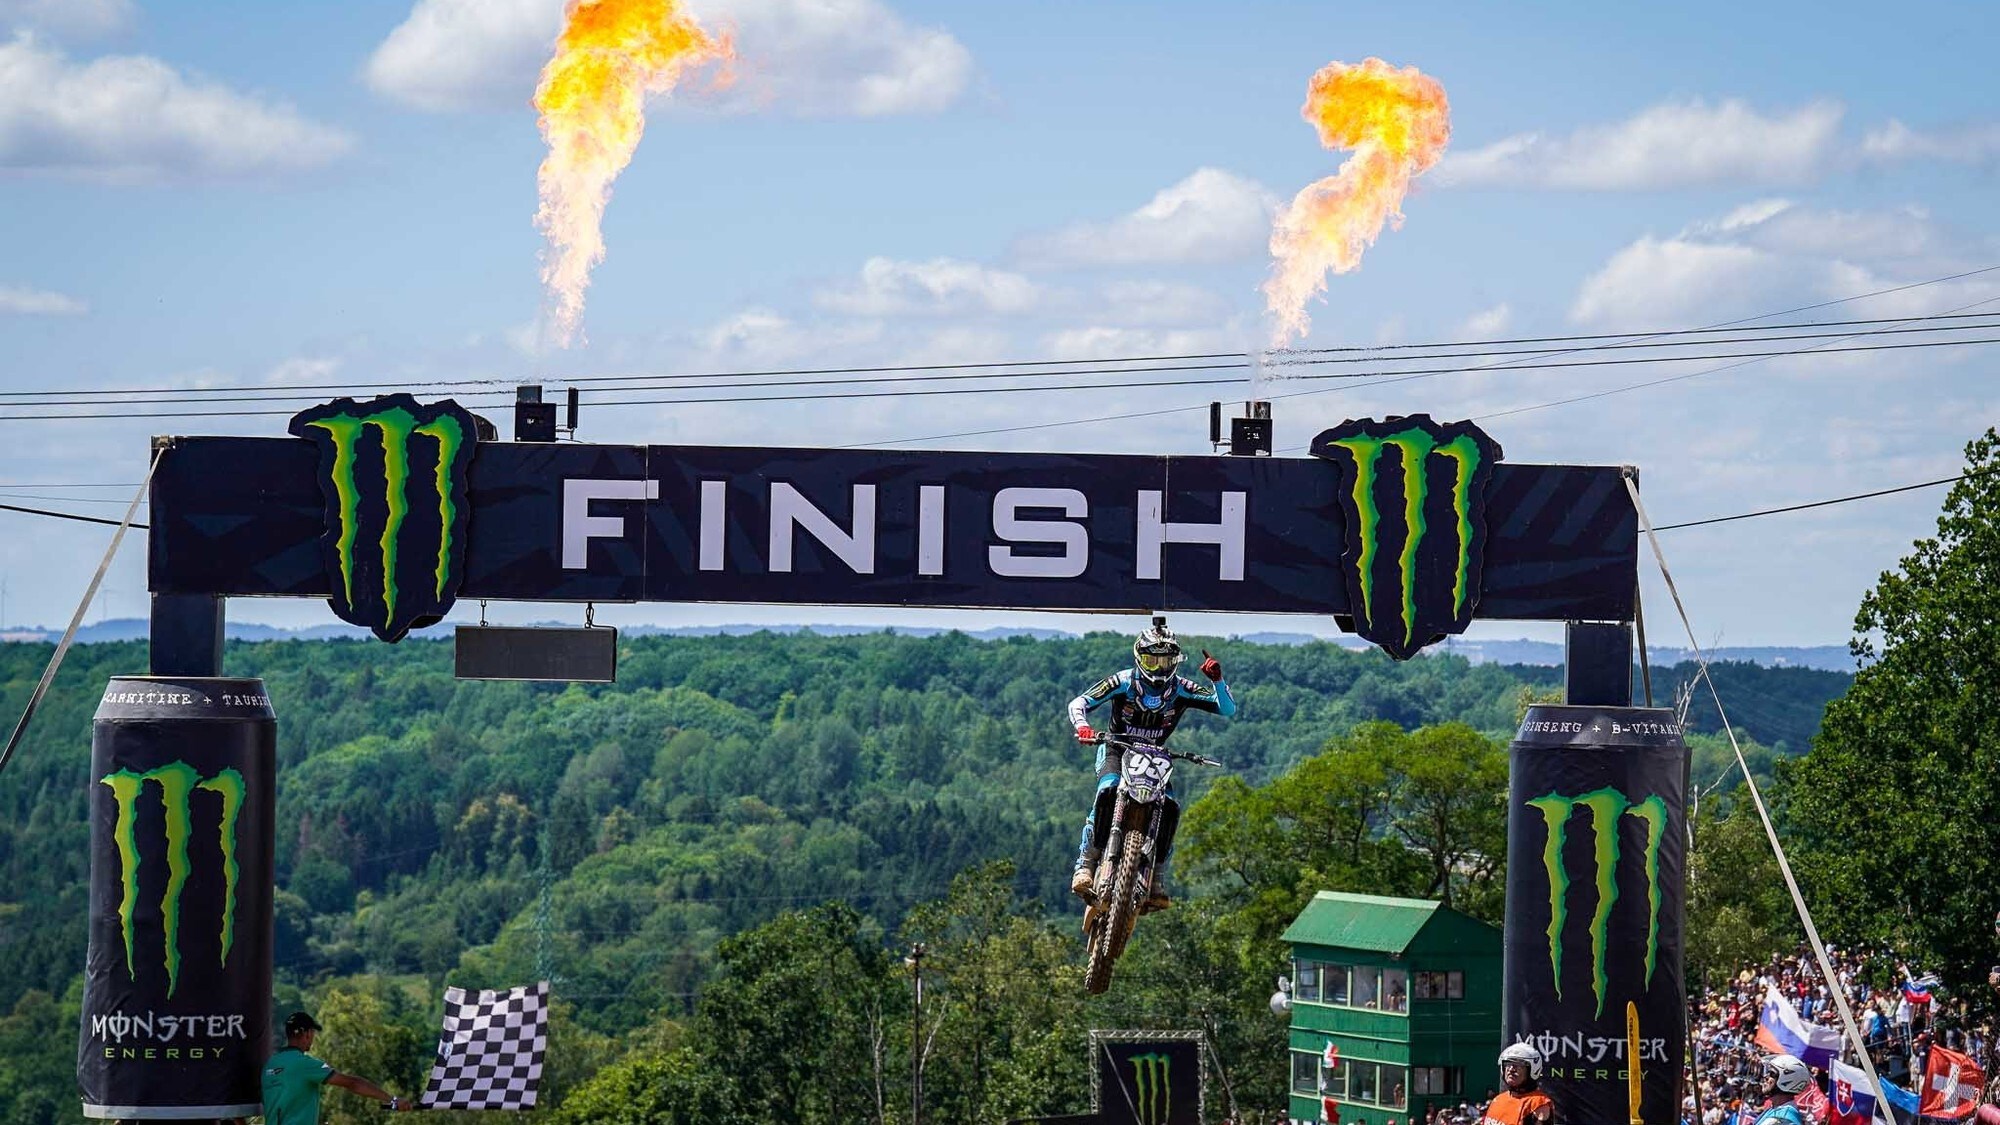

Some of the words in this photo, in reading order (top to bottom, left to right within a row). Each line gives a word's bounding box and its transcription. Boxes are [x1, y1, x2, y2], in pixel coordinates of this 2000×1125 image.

[562, 479, 1246, 581] FINISH
[1126, 725, 1164, 738] YAMAHA
[1524, 721, 1582, 734] GINSENG
[1128, 752, 1171, 780] 93
[92, 1010, 247, 1044] MONSTER
[105, 1048, 224, 1059] ENERGY
[1539, 1067, 1648, 1080] NERGY
